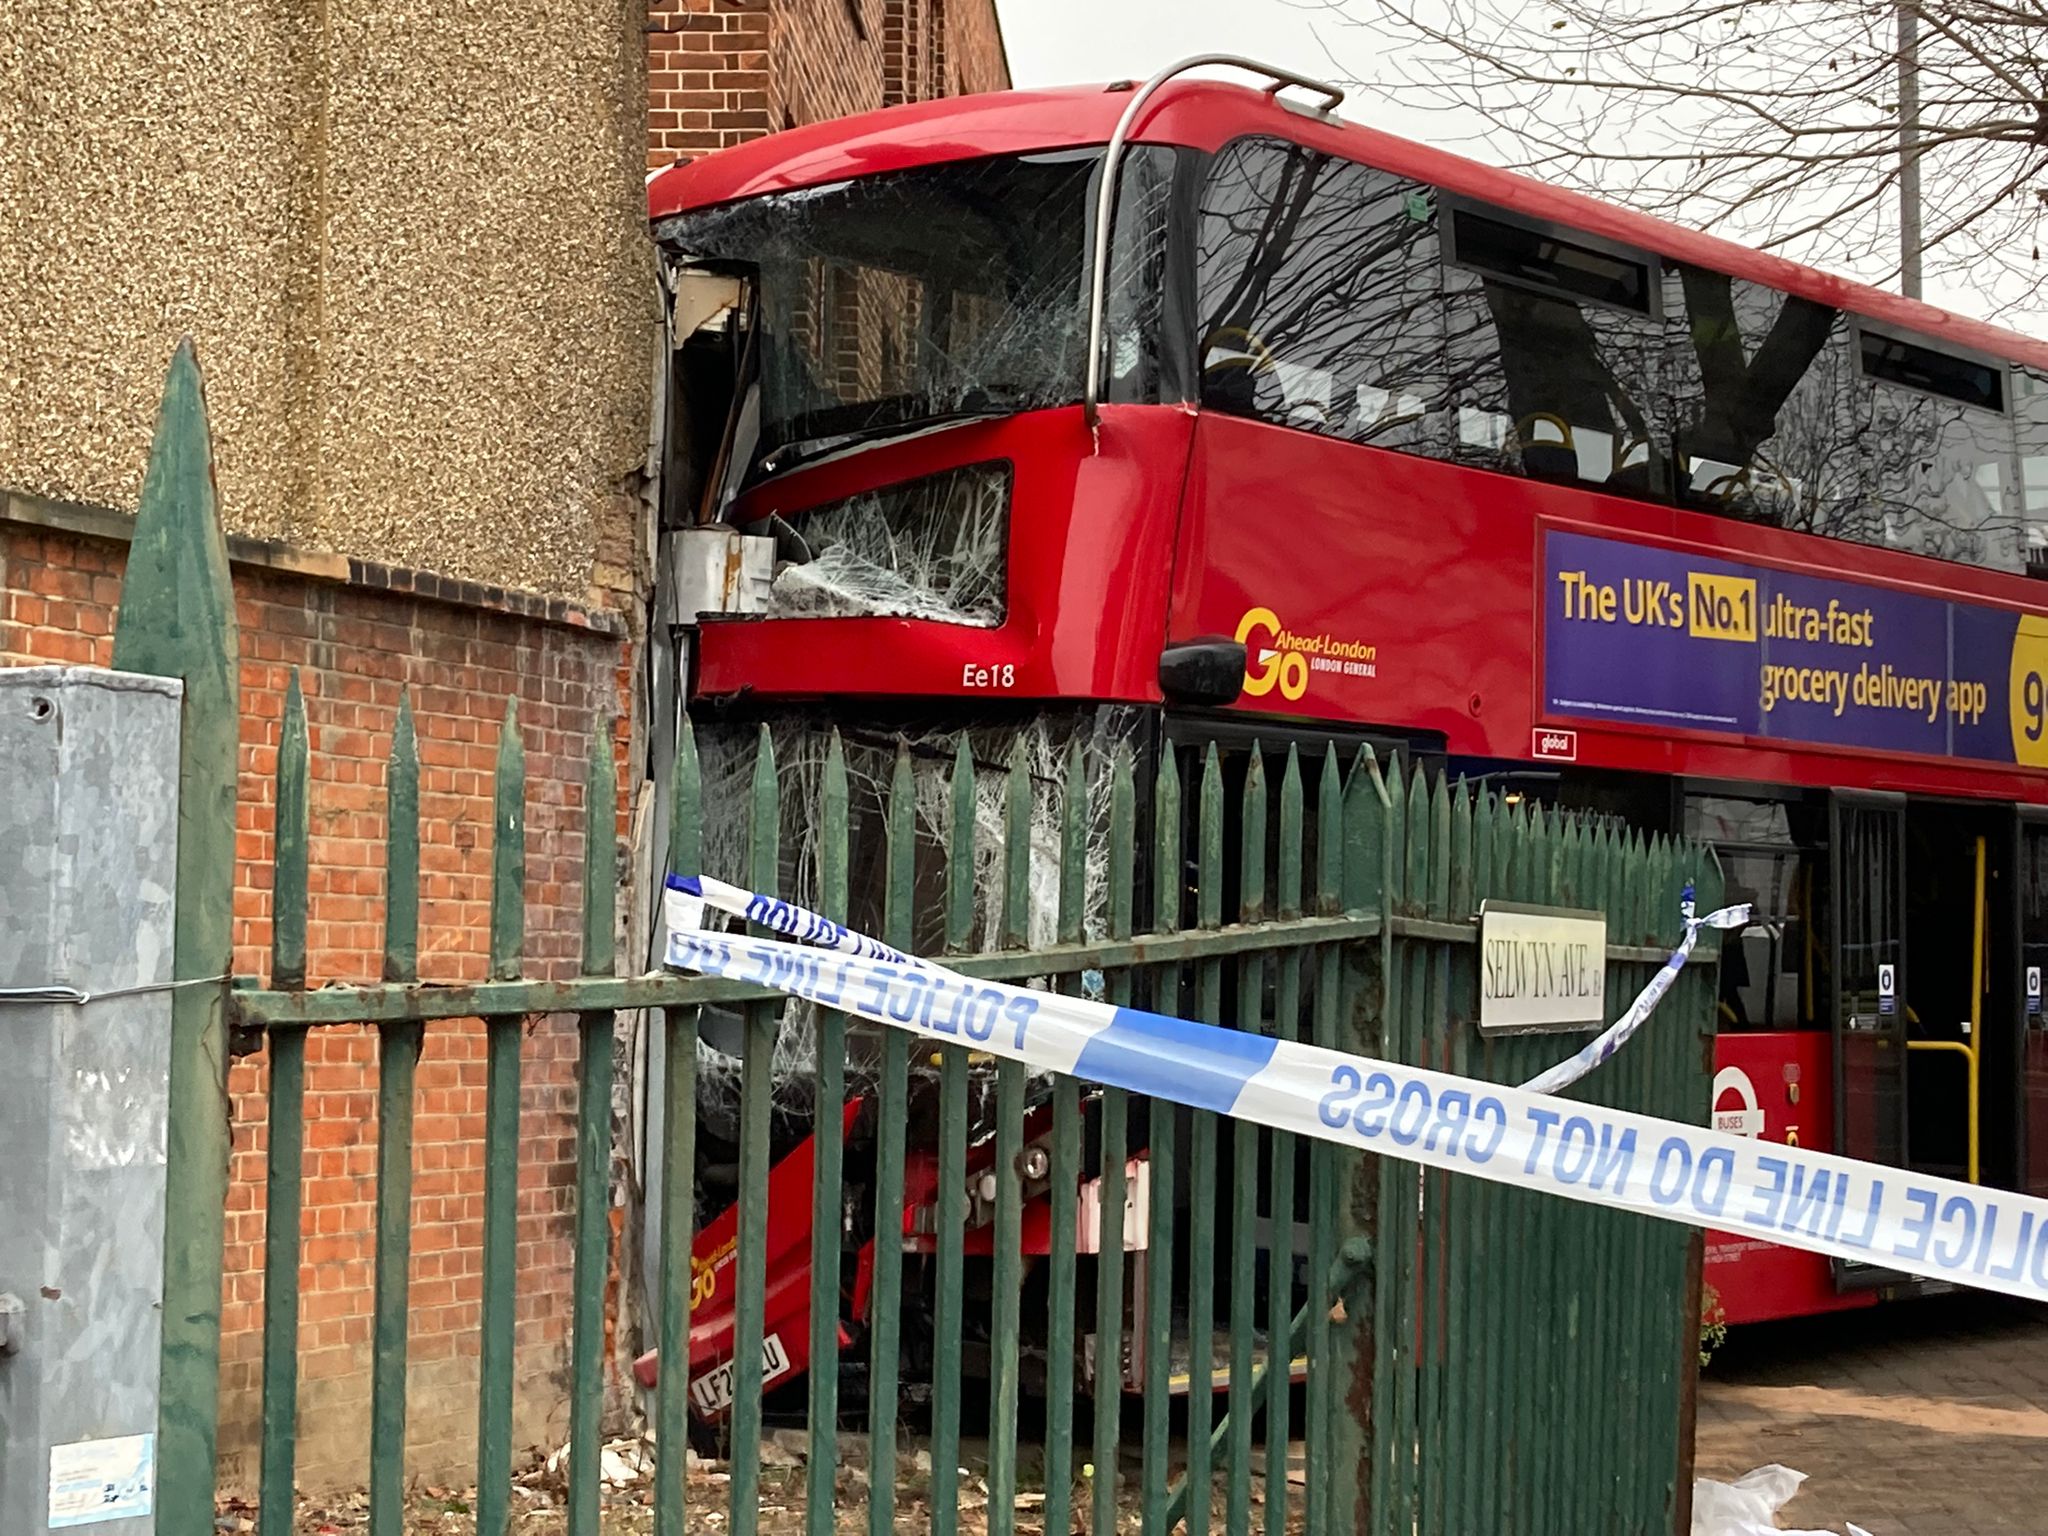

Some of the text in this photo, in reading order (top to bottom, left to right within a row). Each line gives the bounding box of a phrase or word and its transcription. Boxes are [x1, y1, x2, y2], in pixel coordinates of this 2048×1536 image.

[1558, 571, 1874, 647] The UK's No.1 ultra-fast
[1275, 630, 1376, 660] Ahead-London
[962, 663, 1015, 688] Ee18
[1310, 656, 1376, 678] LONDON GENERAL
[1760, 664, 1849, 716] grocery
[1853, 662, 1942, 723] delivery
[1945, 680, 1987, 725] app
[1541, 734, 1568, 753] global
[1485, 939, 1556, 999] SELWYN
[1718, 1116, 1743, 1129] BUSES
